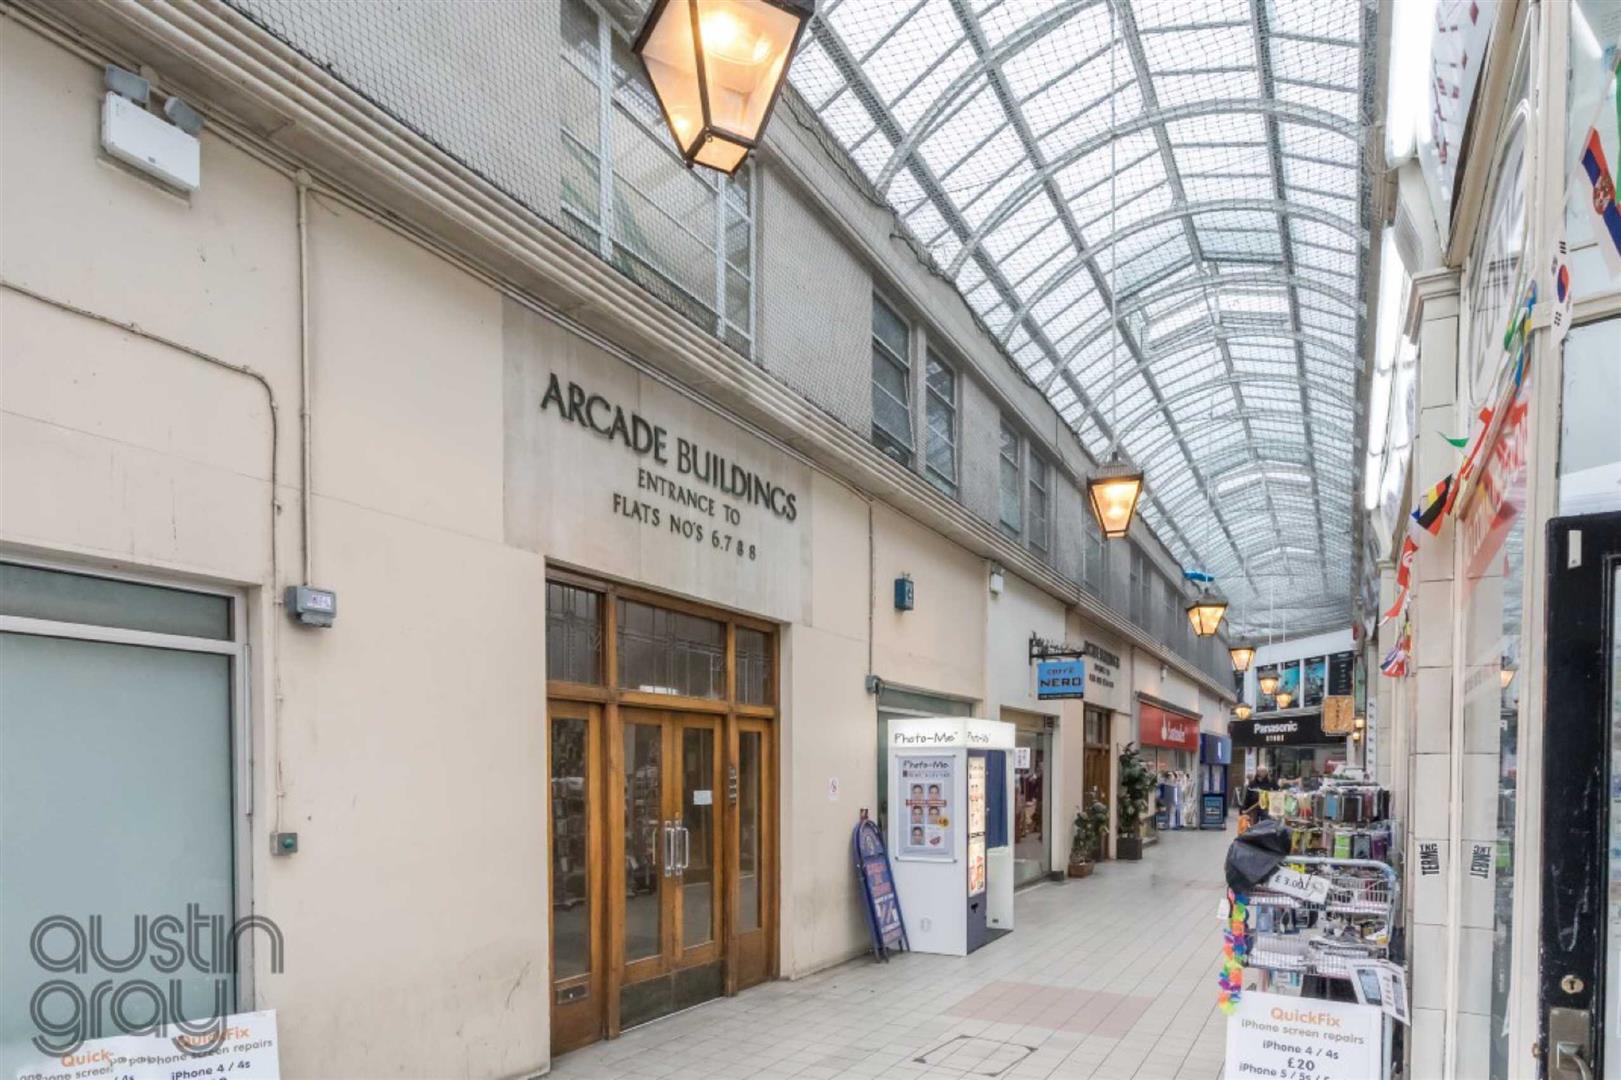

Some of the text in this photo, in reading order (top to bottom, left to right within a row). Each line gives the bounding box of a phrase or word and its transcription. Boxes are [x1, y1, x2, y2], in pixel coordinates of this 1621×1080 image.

[540, 372, 798, 521] ARCADE BUILDINGS
[638, 468, 741, 526] ENTRANCE TO
[613, 493, 660, 527] FLATS
[1040, 677, 1081, 688] NERO
[894, 731, 956, 744] Photo-Me
[1254, 721, 1298, 734] Panasonic
[1271, 1006, 1340, 1027] QuickFix
[1241, 1018, 1364, 1046] iPhone screen repairs
[233, 1038, 273, 1053] repairs
[1262, 1039, 1302, 1054] iPhone
[1305, 1046, 1313, 1056] 4
[1326, 1050, 1339, 1060] 4s
[171, 1067, 213, 1080] iPhone
[217, 1063, 225, 1073] 4
[237, 1060, 250, 1069] 4s
[1239, 1062, 1278, 1077] iPhone
[1287, 1057, 1315, 1072] £20
